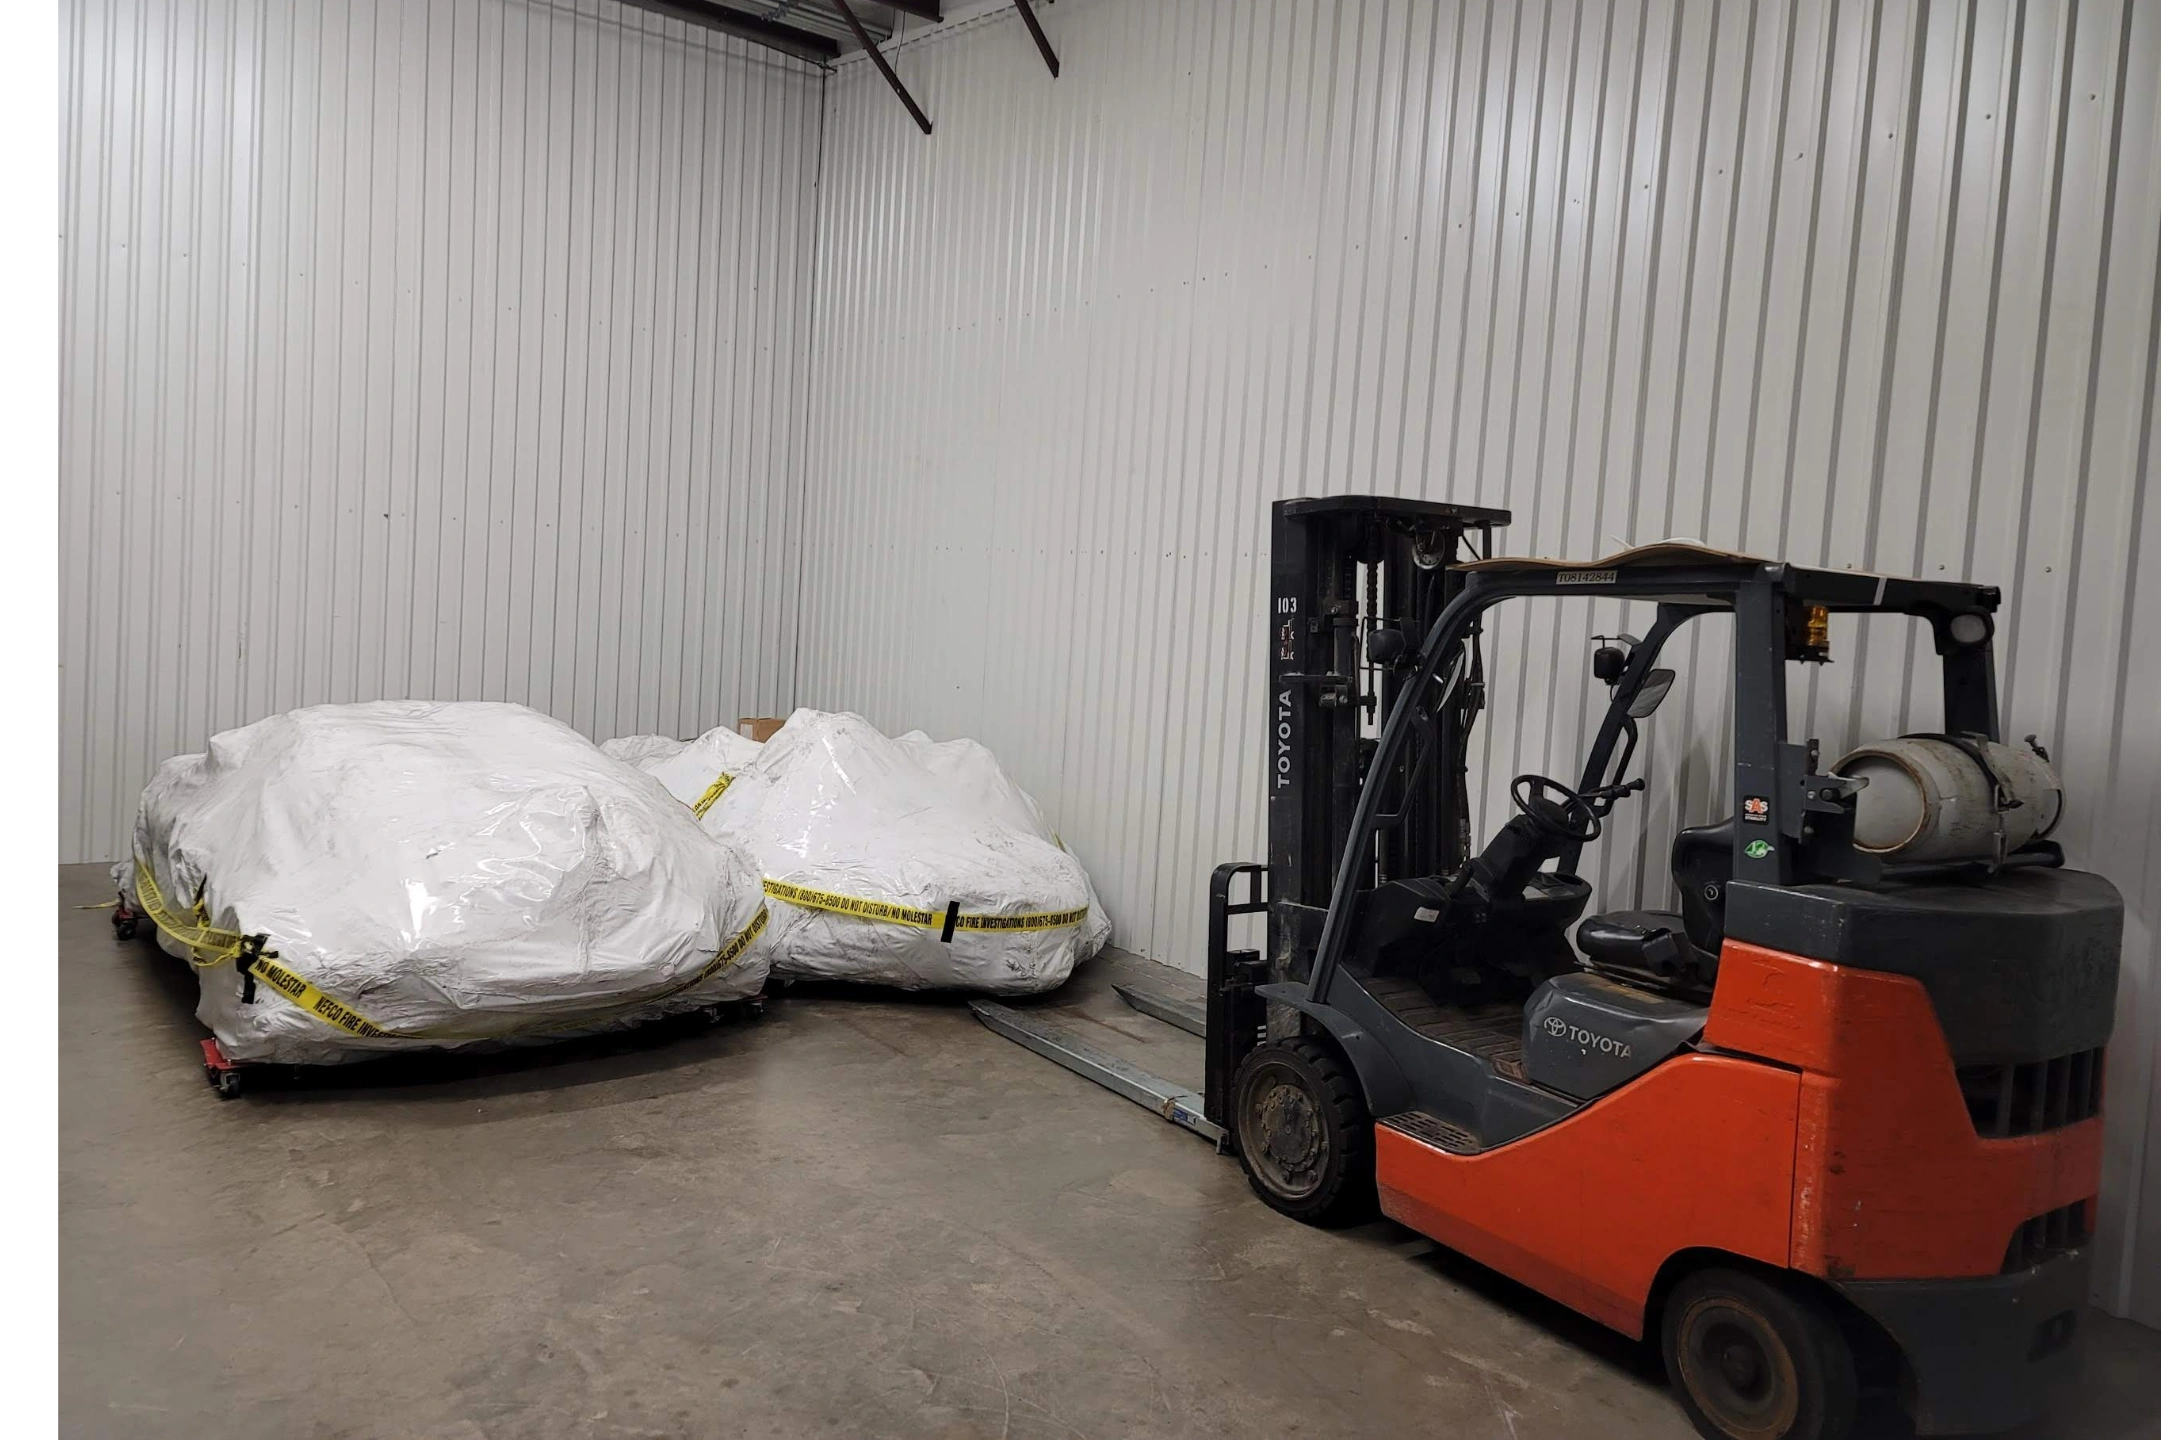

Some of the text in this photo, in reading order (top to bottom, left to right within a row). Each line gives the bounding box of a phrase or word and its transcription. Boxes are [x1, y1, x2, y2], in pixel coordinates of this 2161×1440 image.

[1558, 572, 1615, 583] T08142844
[1277, 597, 1297, 614] 103
[1277, 689, 1292, 789] TOYOTA
[1744, 797, 1769, 814] SAS
[840, 897, 850, 910] DO
[850, 899, 863, 912] NOT
[901, 909, 933, 926] MOLESTAR
[965, 916, 980, 929] FIRE
[255, 959, 270, 974] NO
[266, 965, 307, 999] MOLESTAR
[313, 996, 344, 1021] NEFCO
[338, 1012, 362, 1032] FIRE
[1568, 1025, 1633, 1059] TOYOTA
